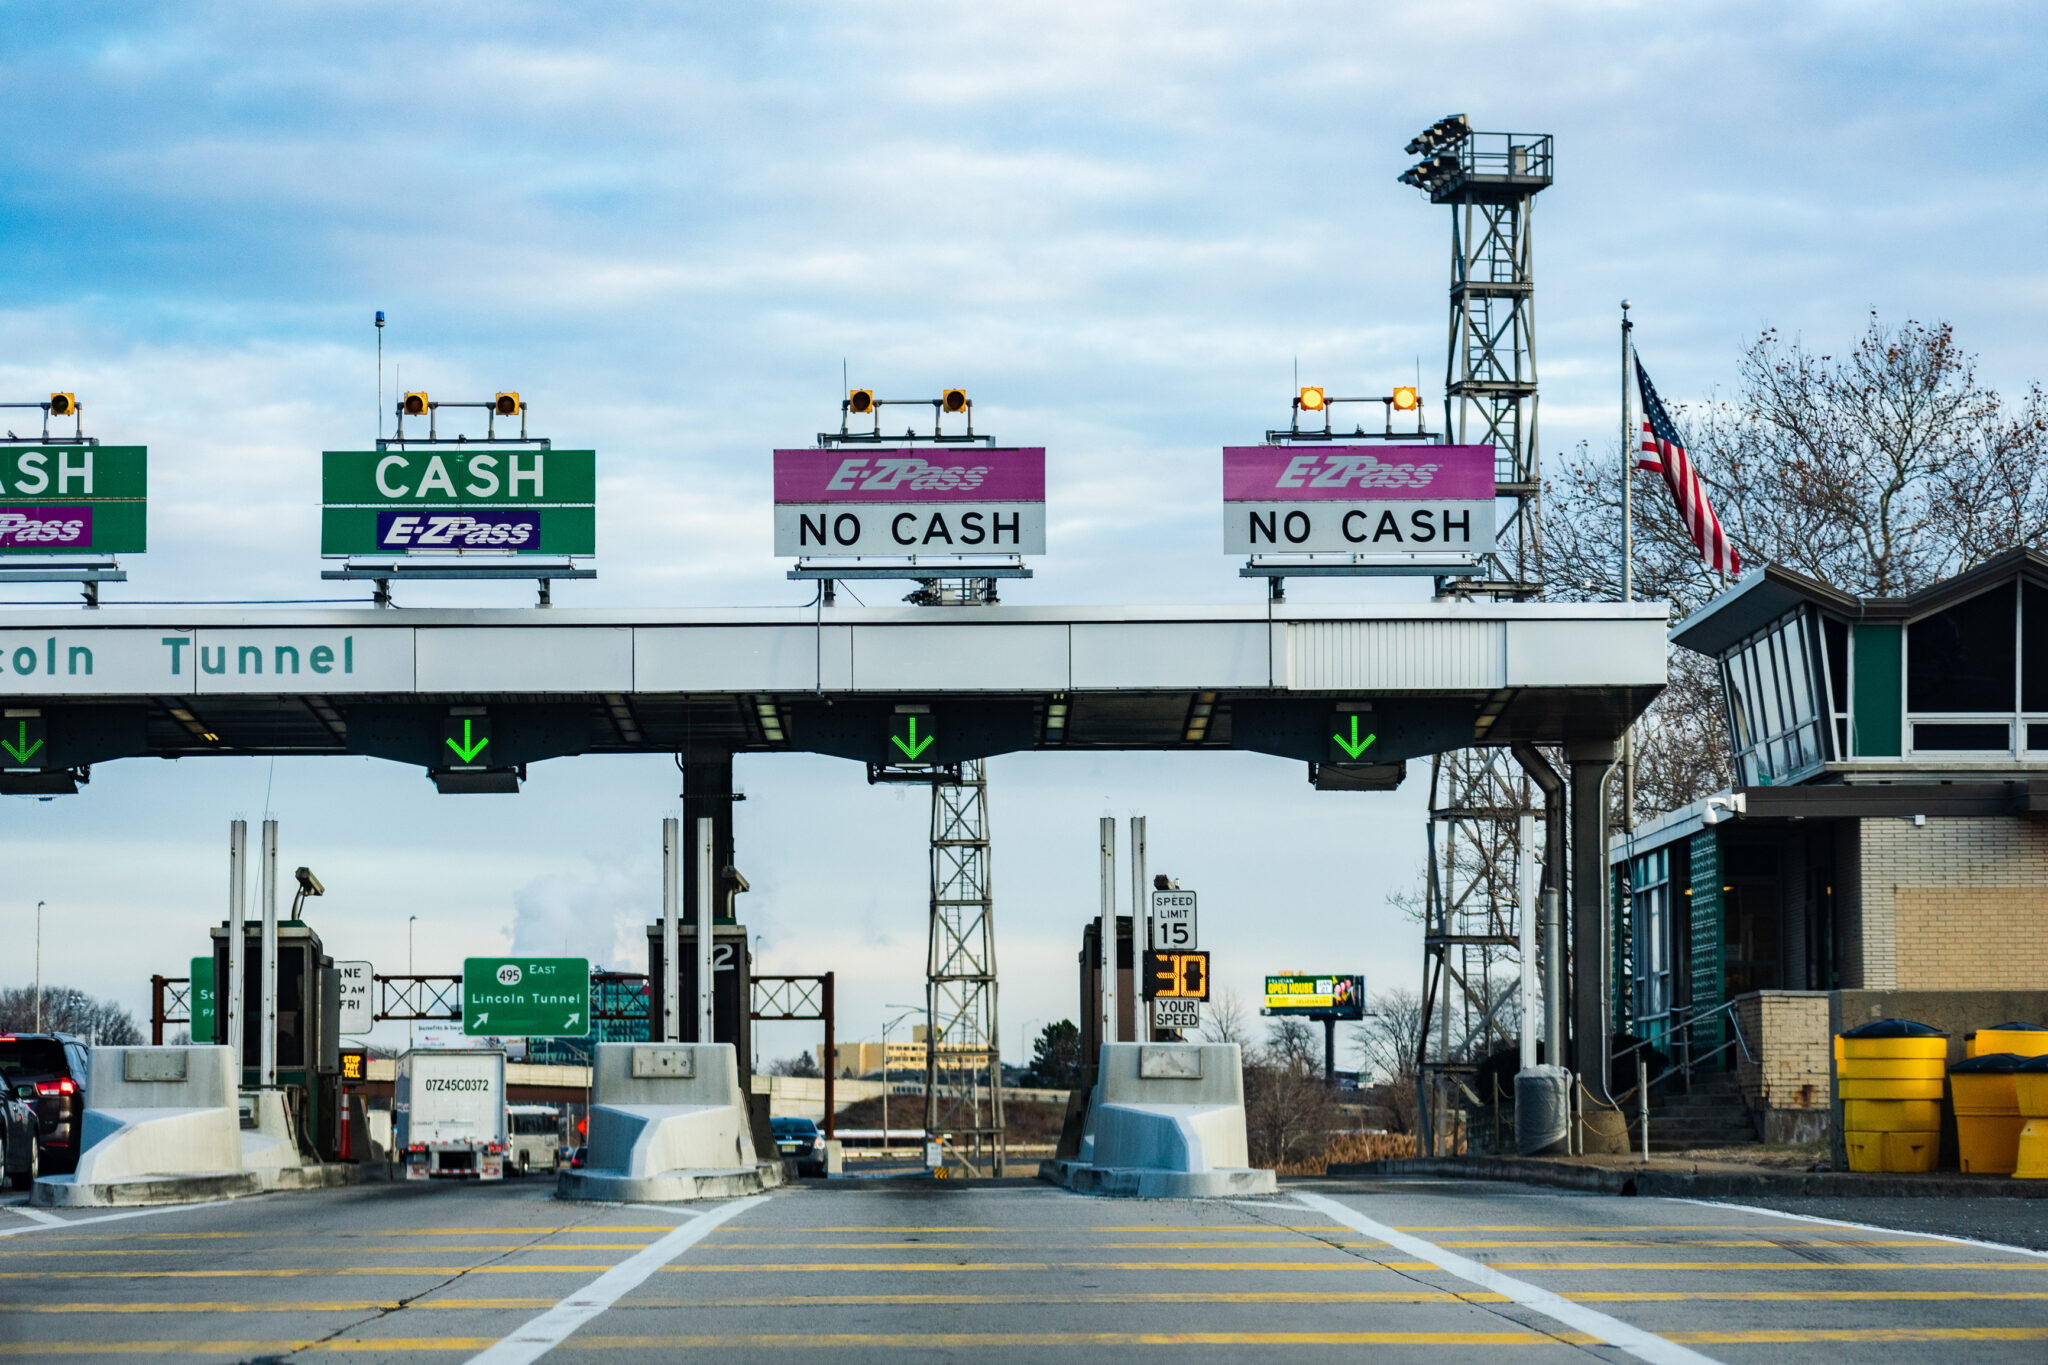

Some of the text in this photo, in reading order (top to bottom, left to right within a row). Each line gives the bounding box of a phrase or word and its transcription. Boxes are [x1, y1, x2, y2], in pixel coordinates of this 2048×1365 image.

[0, 452, 93, 494] SH
[375, 455, 544, 498] CASH
[825, 458, 988, 491] E-ZPass
[1275, 455, 1438, 489] E-ZPass
[383, 516, 533, 545] E-ZPass
[800, 511, 1019, 546] NO CASH
[1250, 509, 1470, 544] NO CASH
[0, 635, 353, 675] oln Tunnel
[1156, 897, 1193, 906] SPEED
[1160, 909, 1189, 919] LIMIT
[1161, 922, 1189, 944] 15
[340, 968, 361, 978] NE
[499, 964, 556, 982] 495 EAST
[1155, 954, 1206, 998] 30
[351, 986, 365, 994] AM
[1267, 982, 1314, 994] OPEN HOUSE
[472, 993, 580, 1004] Lincoln Tunnel
[1160, 1000, 1195, 1013] YOUR
[1156, 1014, 1198, 1026] SPEED
[343, 1055, 361, 1063] STOP
[343, 1070, 361, 1078] TOLL
[425, 1079, 489, 1092] 07Z45C0372
